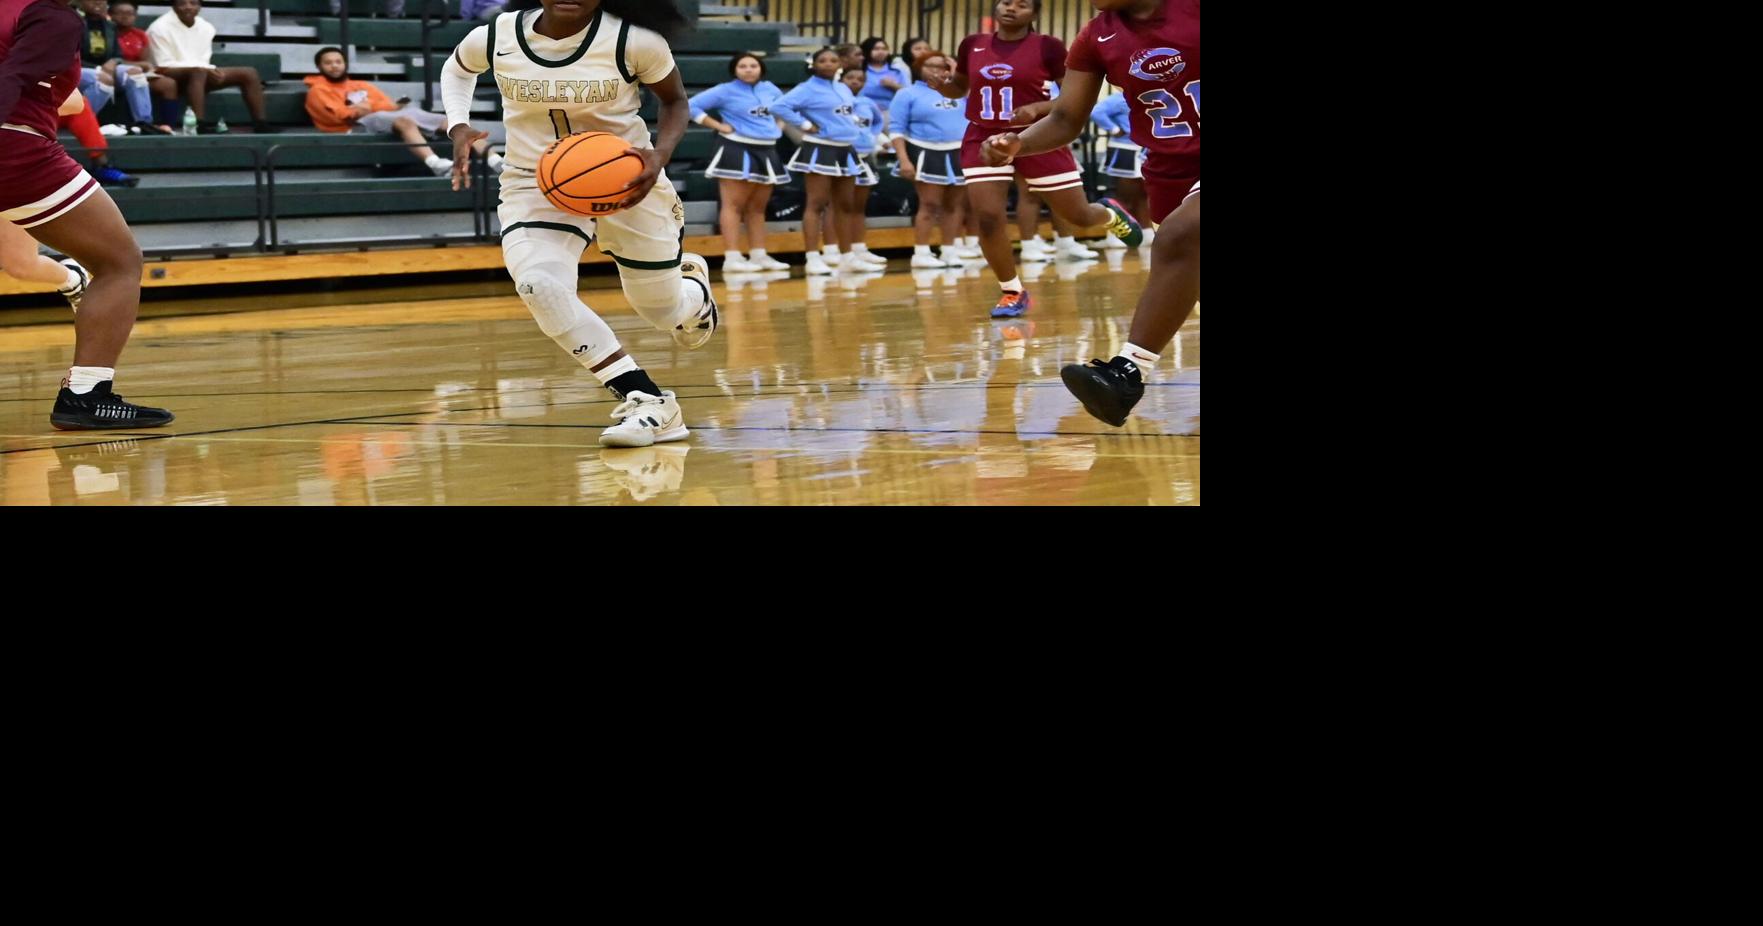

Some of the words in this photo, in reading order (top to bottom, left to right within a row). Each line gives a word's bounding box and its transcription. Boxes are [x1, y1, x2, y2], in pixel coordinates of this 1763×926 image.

[496, 73, 620, 103] WESLEYAN
[979, 85, 1015, 121] 11
[548, 108, 571, 140] 1
